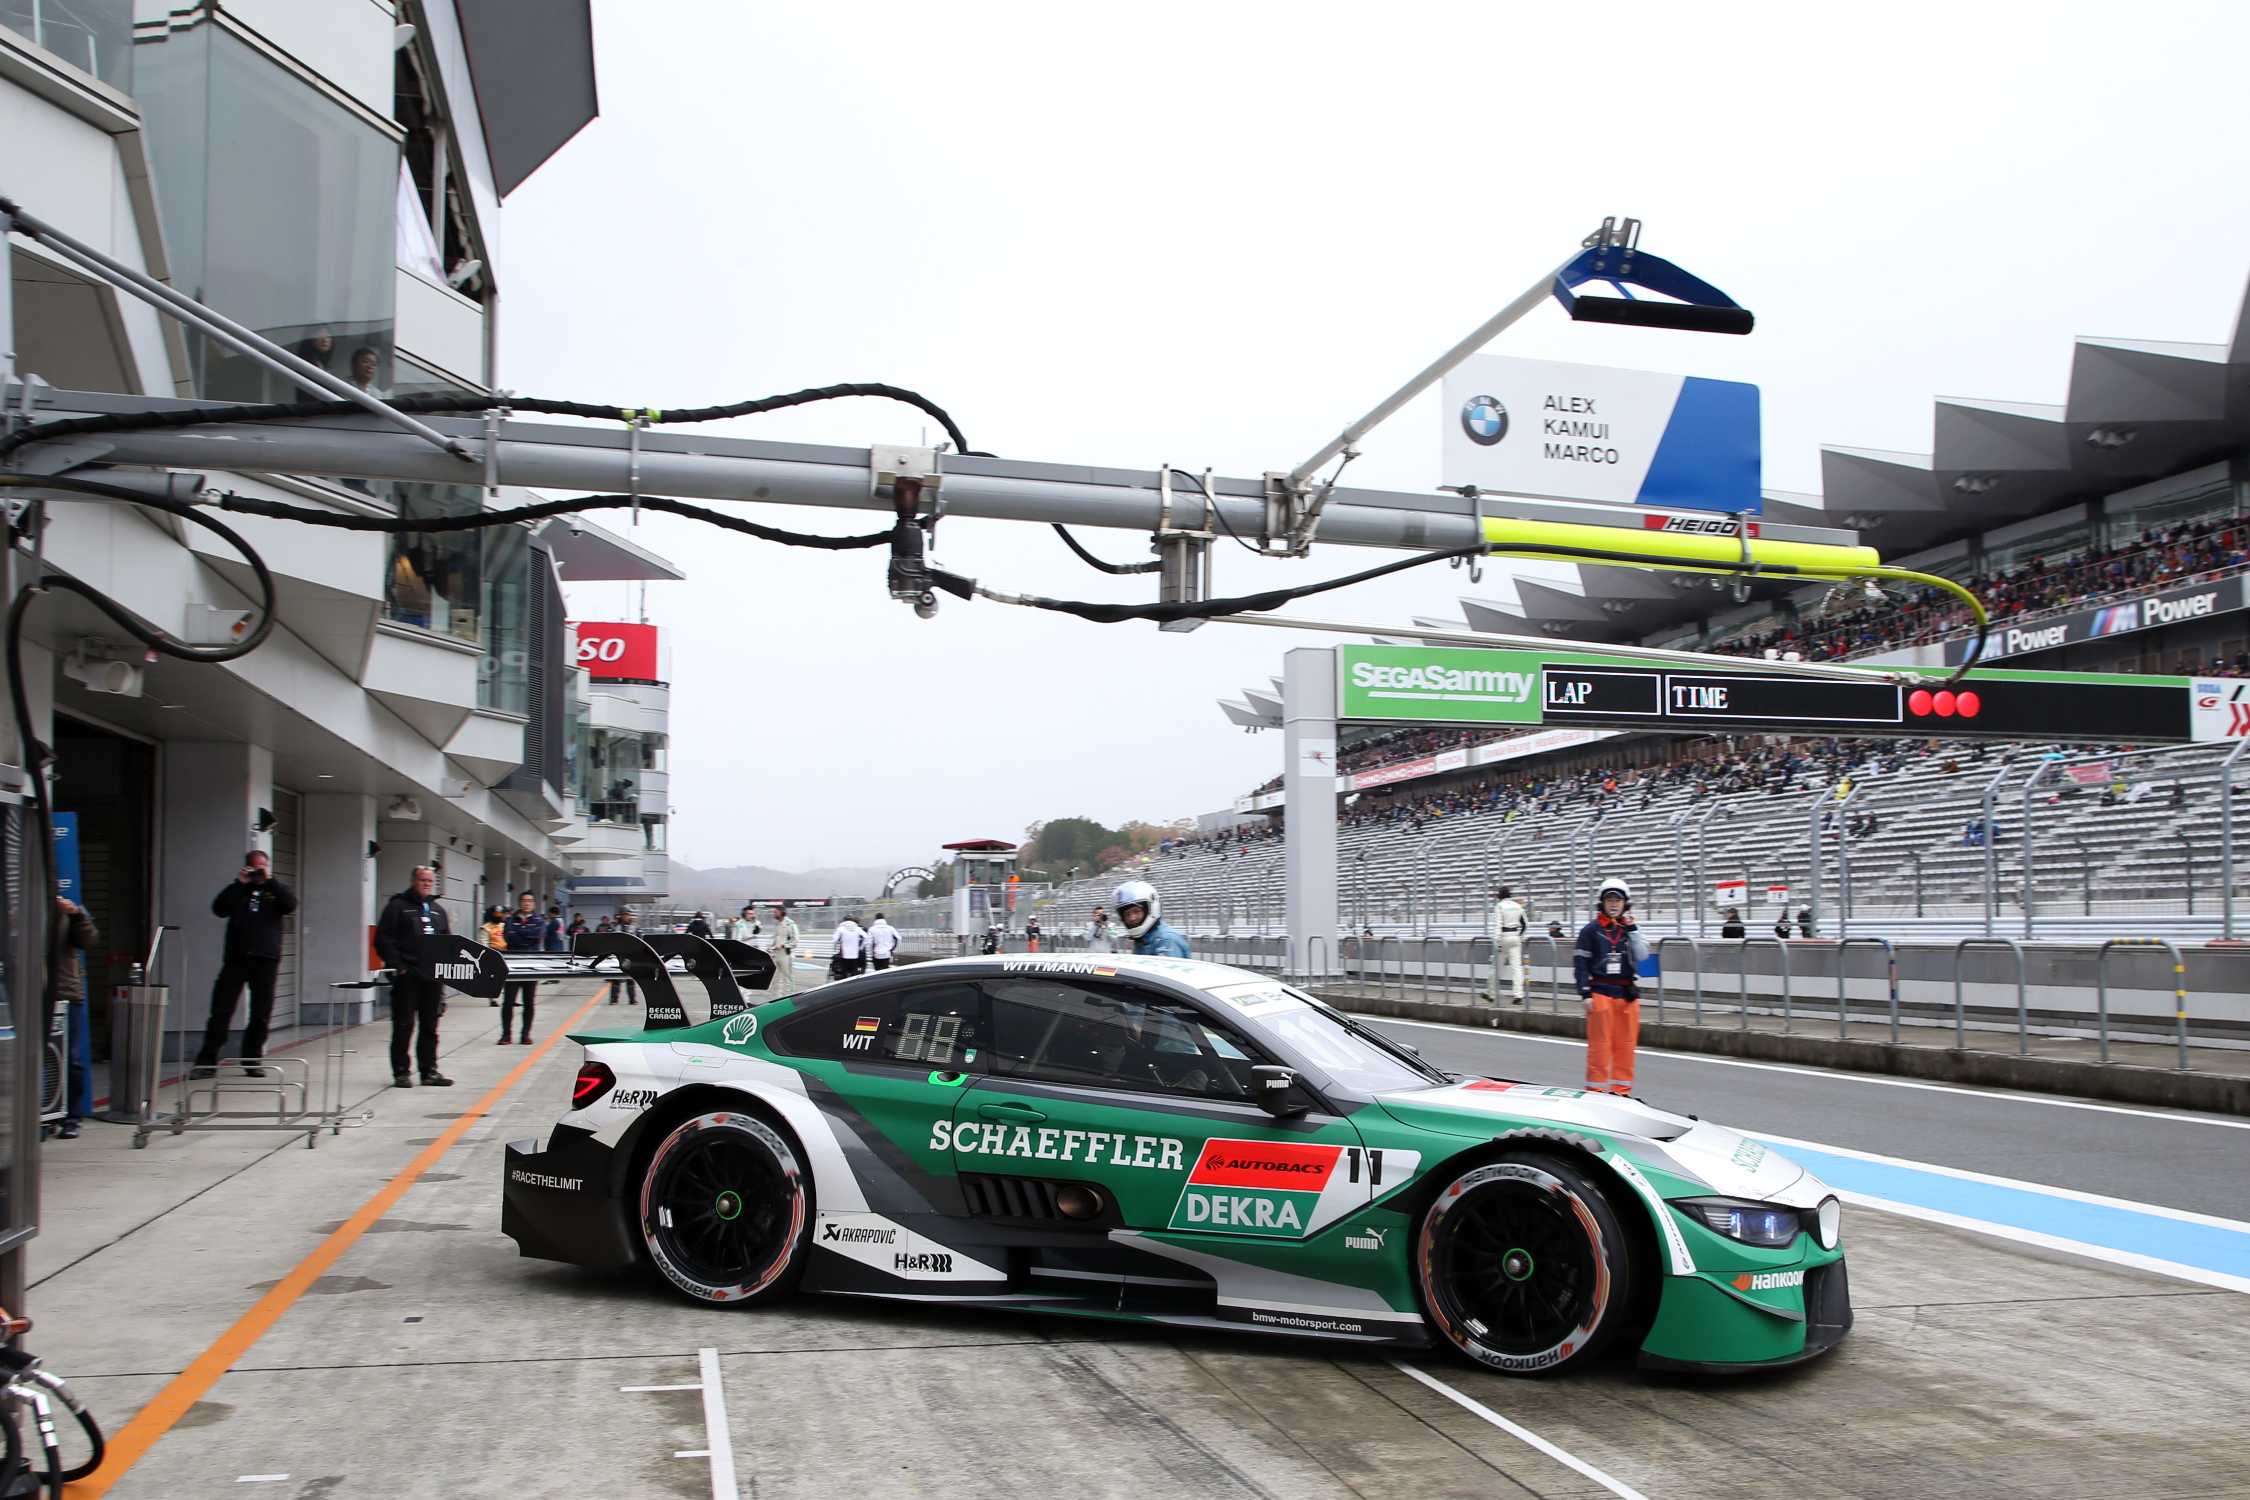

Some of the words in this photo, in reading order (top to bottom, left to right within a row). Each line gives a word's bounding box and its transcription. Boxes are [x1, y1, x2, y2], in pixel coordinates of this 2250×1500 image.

[1543, 395, 1596, 415] ALEX
[1543, 418, 1610, 440] KAMUI
[1543, 442, 1619, 465] MARCO
[1667, 518, 1738, 534] HEIGO
[2143, 592, 2217, 625] Power
[576, 637, 626, 662] SO
[2006, 625, 2067, 653] Power
[1548, 681, 1593, 705] LAP
[1671, 685, 1729, 709] TIME
[434, 963, 474, 980] PUMA
[1002, 960, 1095, 975] WITTMANN
[842, 1034, 875, 1050] WIT
[1266, 1079, 1289, 1089] PUMA
[929, 1119, 1185, 1171] SCHAEFFLER
[1225, 1158, 1325, 1175] AUTOBACS
[1347, 1148, 1384, 1186] 11
[511, 1169, 584, 1191] #RACETHELIMIT
[1186, 1193, 1302, 1230] DEKRA
[1345, 1236, 1378, 1250] PUMA
[1252, 1312, 1362, 1332] bmw-motorsport.com
